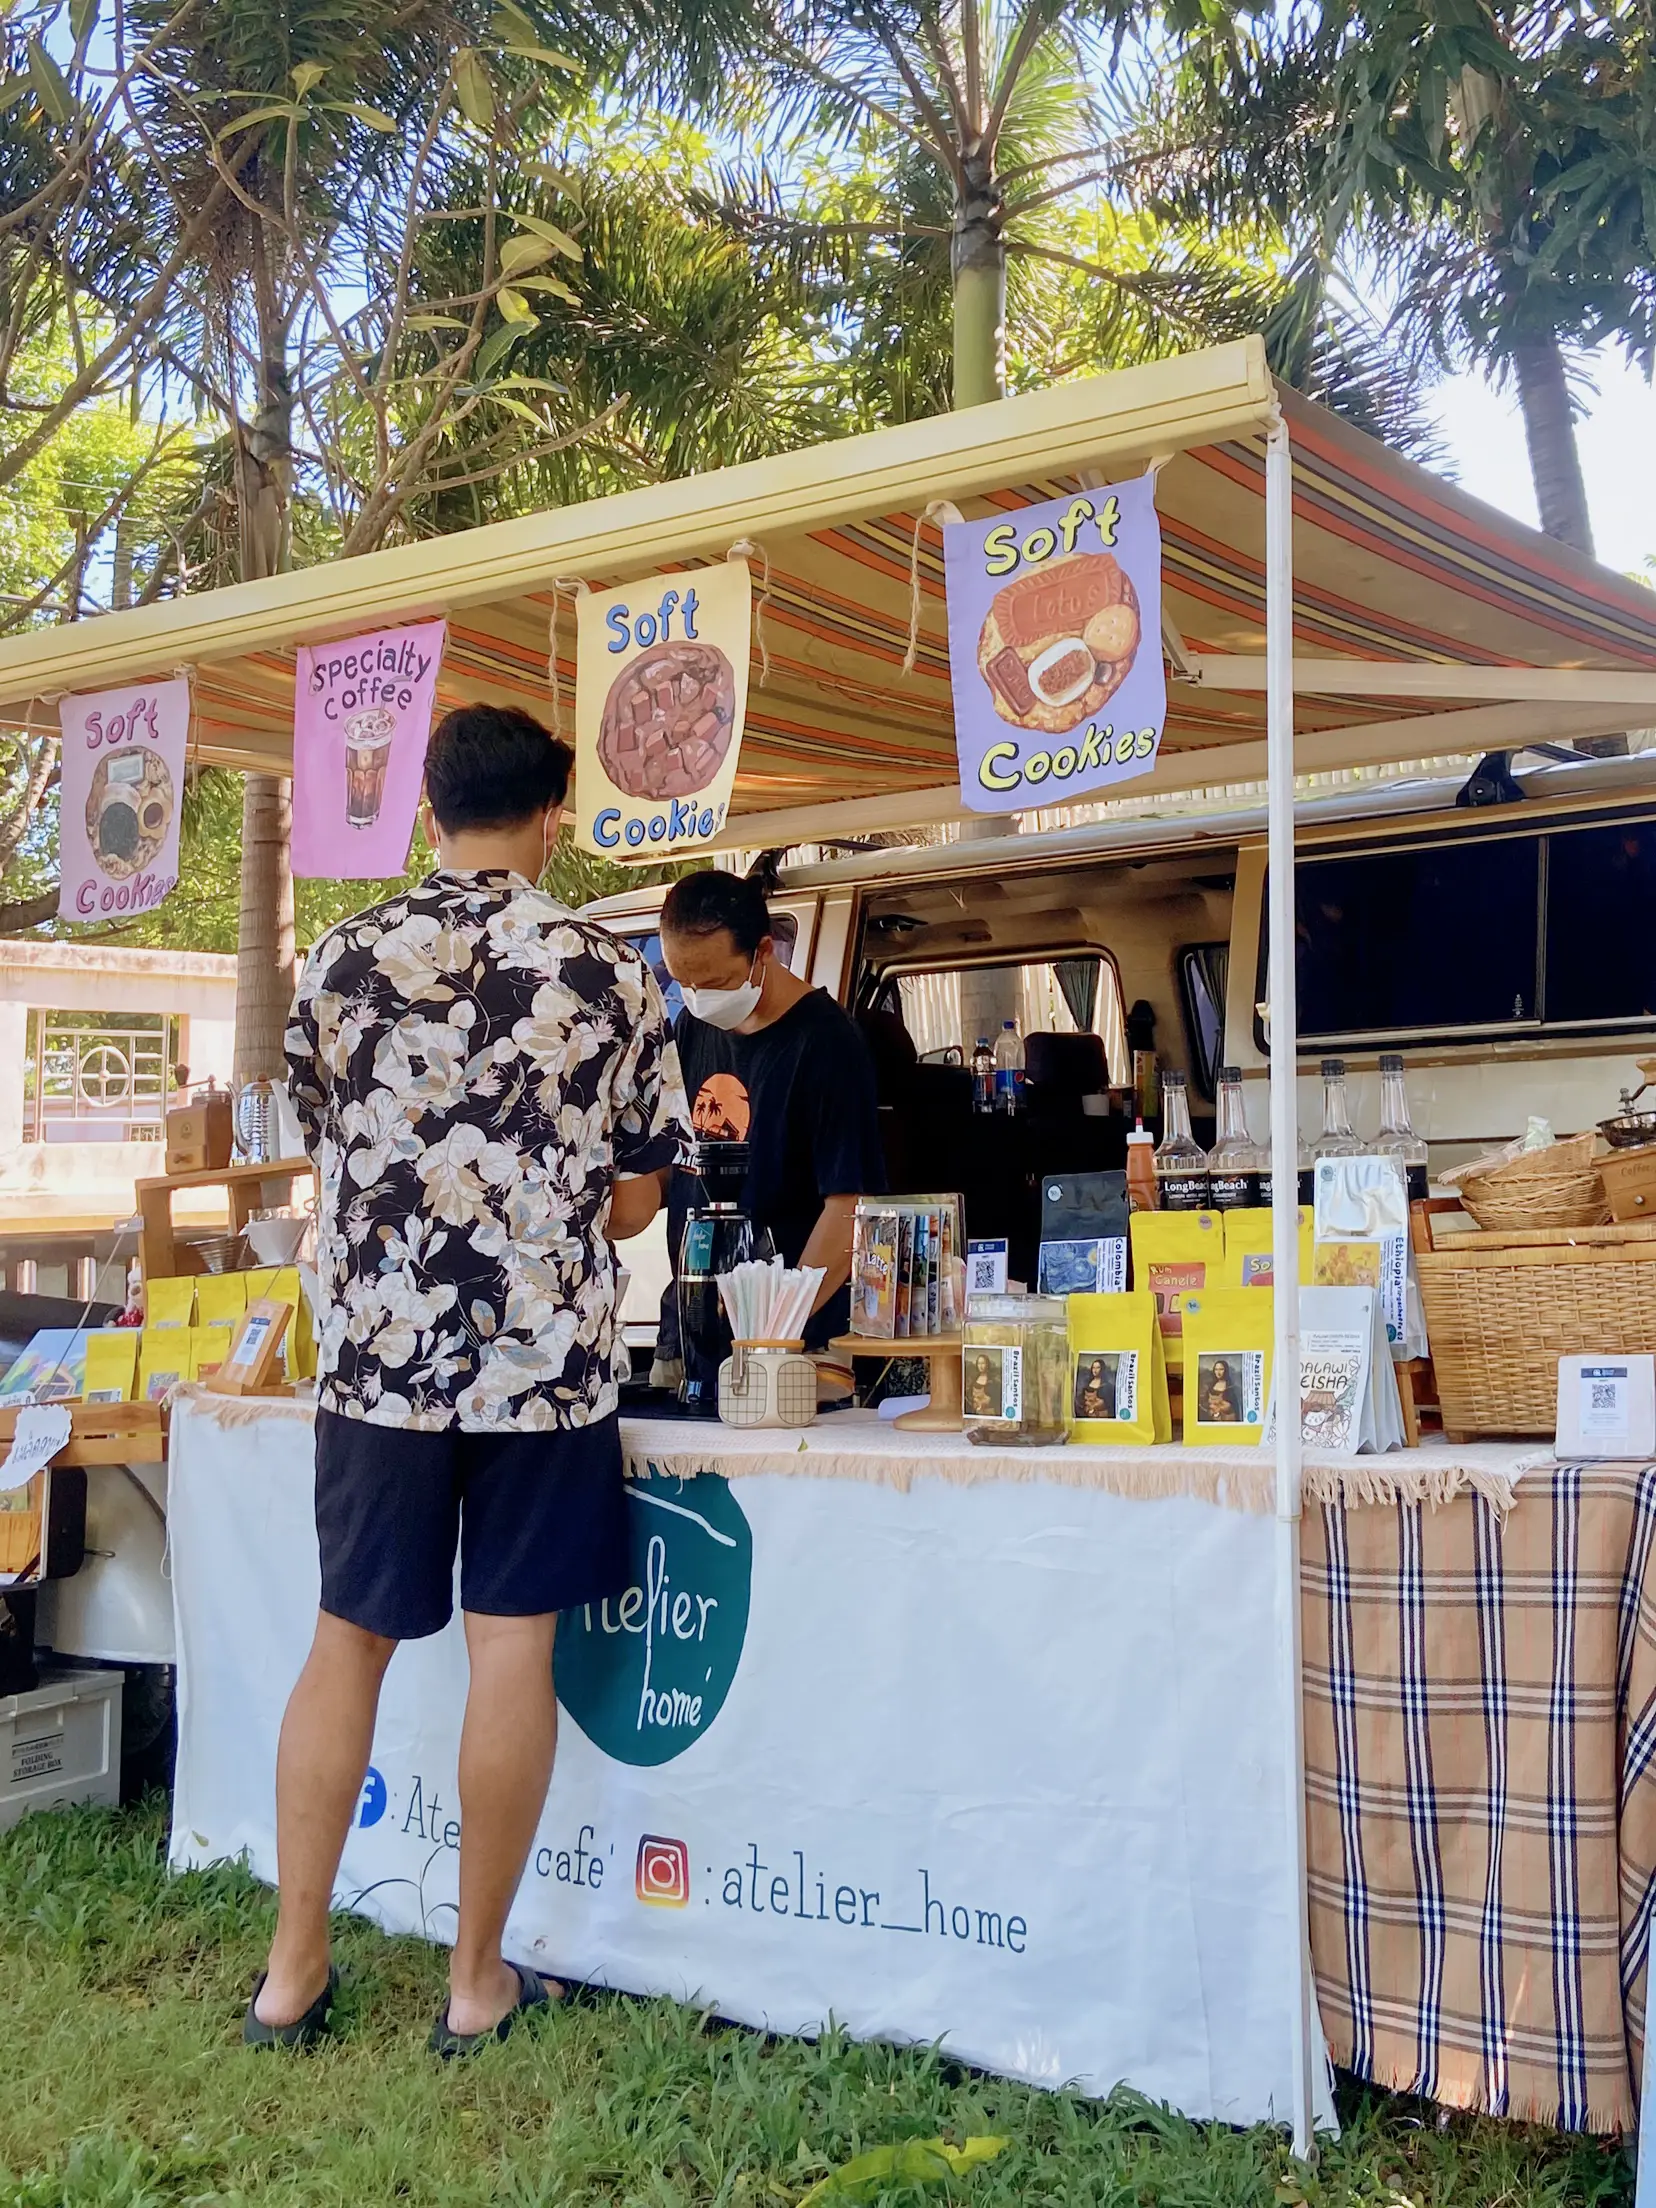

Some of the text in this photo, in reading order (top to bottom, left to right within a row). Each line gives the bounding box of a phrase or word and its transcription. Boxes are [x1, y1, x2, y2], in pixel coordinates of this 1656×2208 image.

[983, 495, 1121, 576] Soft
[606, 588, 699, 653] Soft
[324, 677, 412, 720] coffee
[85, 697, 159, 749] Soft
[978, 723, 1156, 792] Cookies
[1164, 1180, 1208, 1193] LongBeac
[1211, 1179, 1247, 1192] ngBeach
[1114, 1238, 1123, 1286] Colombia
[1250, 1258, 1271, 1273] So
[1393, 1237, 1404, 1286] Ethiopia
[1128, 1353, 1137, 1379] Brazil
[1254, 1354, 1262, 1381] Brazil
[1300, 1374, 1348, 1389] EISHA
